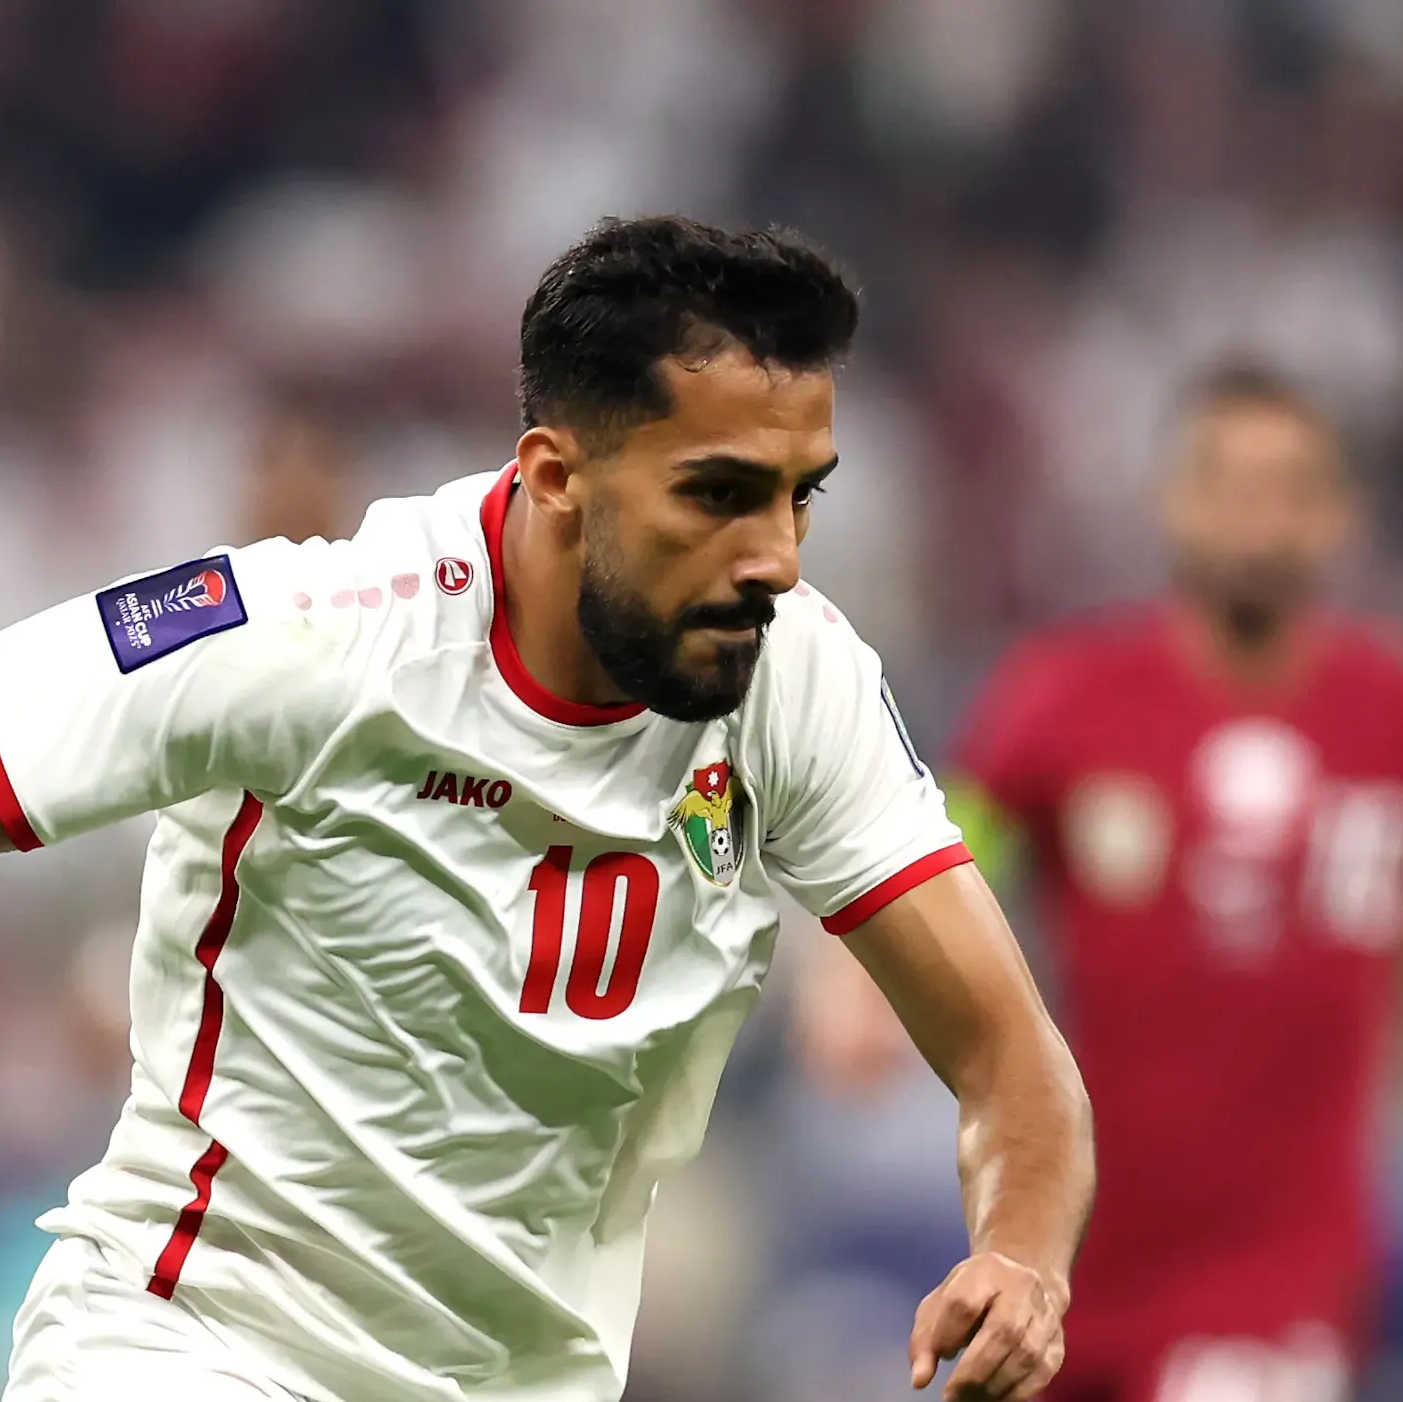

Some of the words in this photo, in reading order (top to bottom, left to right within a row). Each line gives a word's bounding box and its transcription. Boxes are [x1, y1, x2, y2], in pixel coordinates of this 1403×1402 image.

[125, 593, 143, 623] ASIAN
[135, 622, 152, 646] CUP
[140, 605, 152, 621] AFC
[416, 770, 512, 808] JAKO
[716, 862, 733, 875] JFA
[519, 845, 660, 1020] 10
